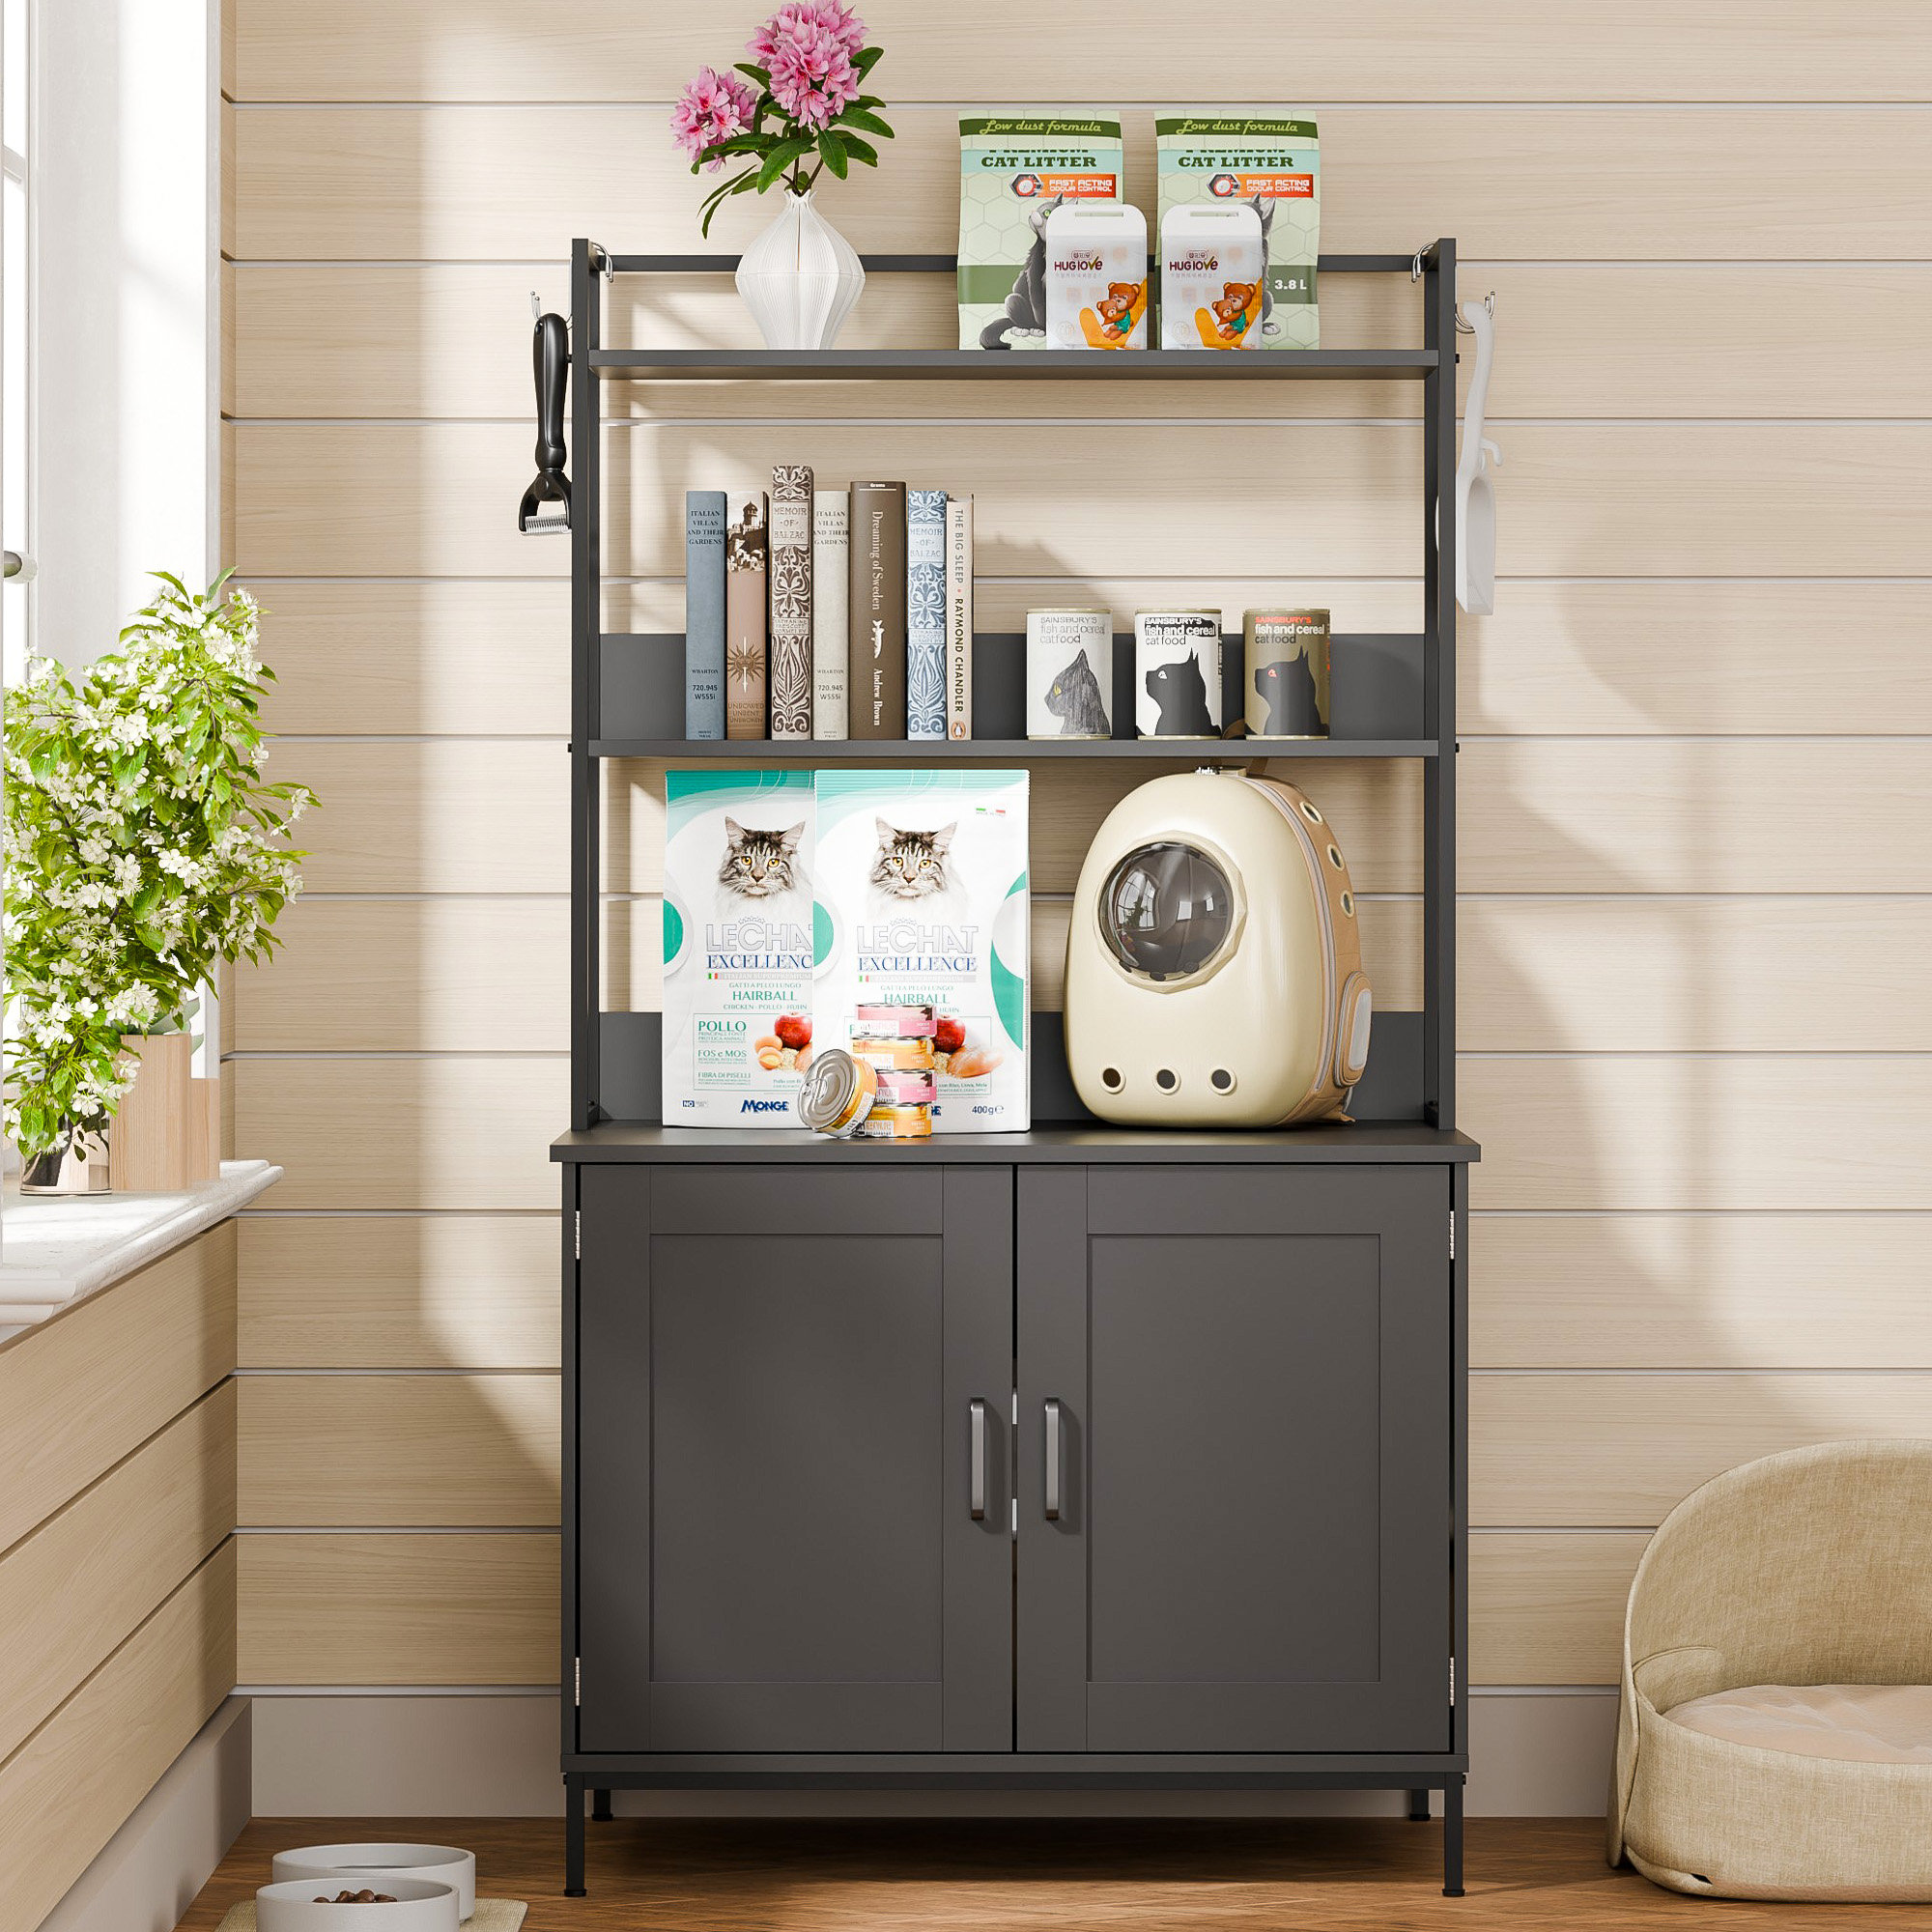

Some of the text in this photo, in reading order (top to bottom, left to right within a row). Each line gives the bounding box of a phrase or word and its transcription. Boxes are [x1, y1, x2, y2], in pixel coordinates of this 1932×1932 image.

[980, 120, 1102, 135] Low dust formula
[1176, 120, 1298, 135] Low dust formula
[981, 156, 1097, 167] CAT LITTER
[1179, 156, 1294, 167] CAT LITTER
[1274, 278, 1307, 290] 3.8 L
[774, 507, 807, 516] MEMOIR
[774, 530, 805, 539] BALZAC
[869, 511, 884, 611] Dreaming of Sweden
[954, 509, 964, 713] THE BIG SLEEP RAYMOND CHANDLER
[1041, 624, 1058, 634] fish
[1060, 624, 1079, 634] and
[1146, 624, 1215, 636] fish and cereal
[1255, 623, 1325, 635] fish and cereal
[1040, 634, 1081, 644] cat food
[1146, 635, 1186, 645] cat food
[1255, 634, 1296, 644] cat food
[873, 668, 883, 726] Andrew Brown
[706, 923, 812, 952] LECHA
[856, 924, 980, 953] LECHAT
[706, 954, 812, 969] EXCELLENC
[857, 956, 978, 972] EXCELLENCE
[732, 990, 798, 1001] HAIRBALL
[884, 993, 951, 1004] HAIRBALL
[698, 1020, 747, 1032] POLLO
[697, 1049, 716, 1058] FOS
[724, 1049, 748, 1058] MOS
[740, 1099, 789, 1113] MONGE
